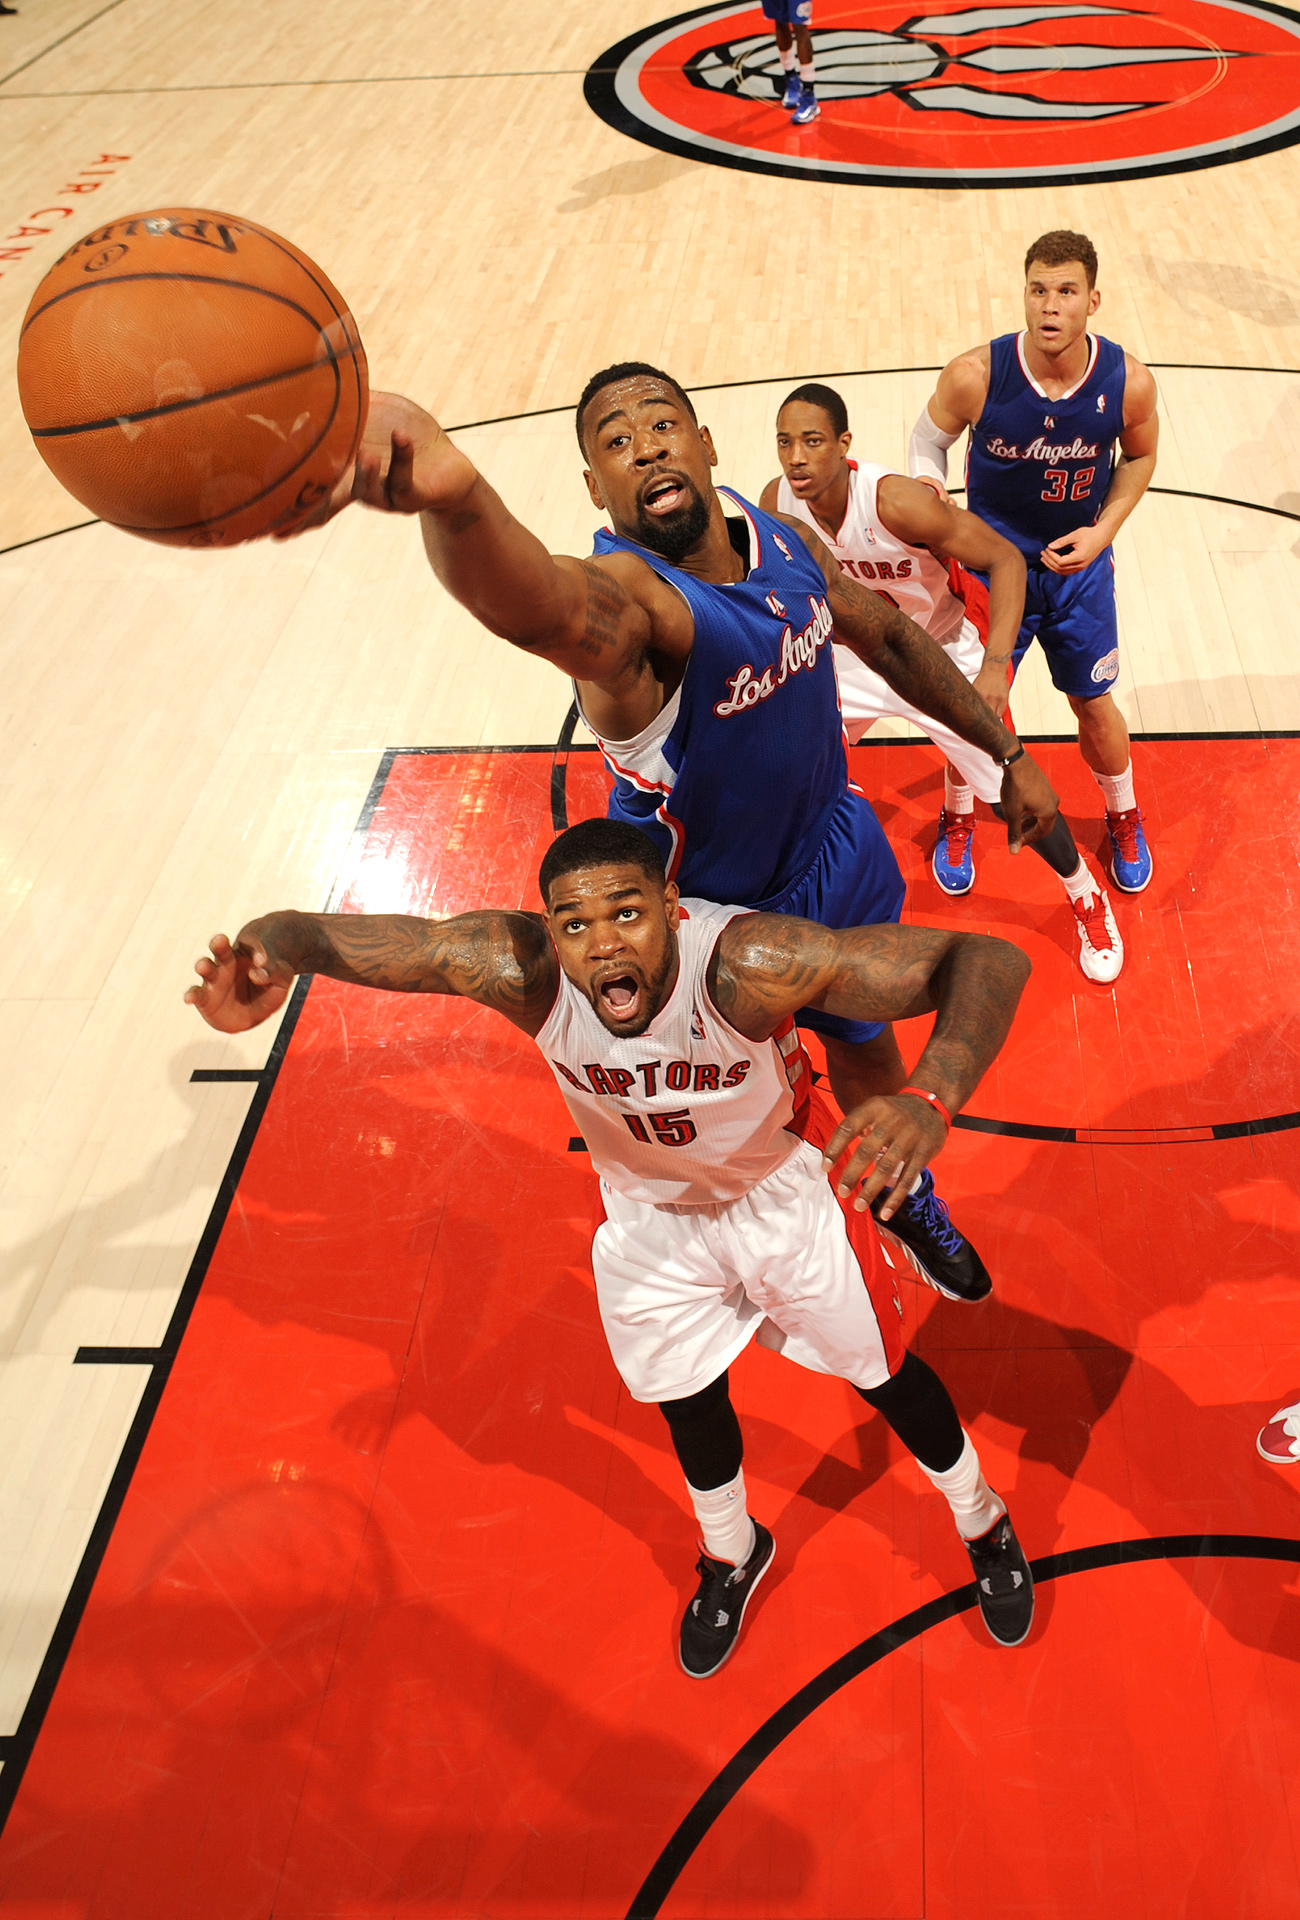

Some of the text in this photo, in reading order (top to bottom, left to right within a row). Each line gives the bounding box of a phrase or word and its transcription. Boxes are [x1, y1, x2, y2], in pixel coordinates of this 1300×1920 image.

[0, 153, 131, 279] AIR CAN
[986, 434, 1100, 466] Los Angeles
[1040, 466, 1096, 502] 32
[837, 558, 913, 580] TORS
[713, 664, 775, 718] Los
[552, 1058, 752, 1098] RAPTORS
[622, 1107, 698, 1147] 15
